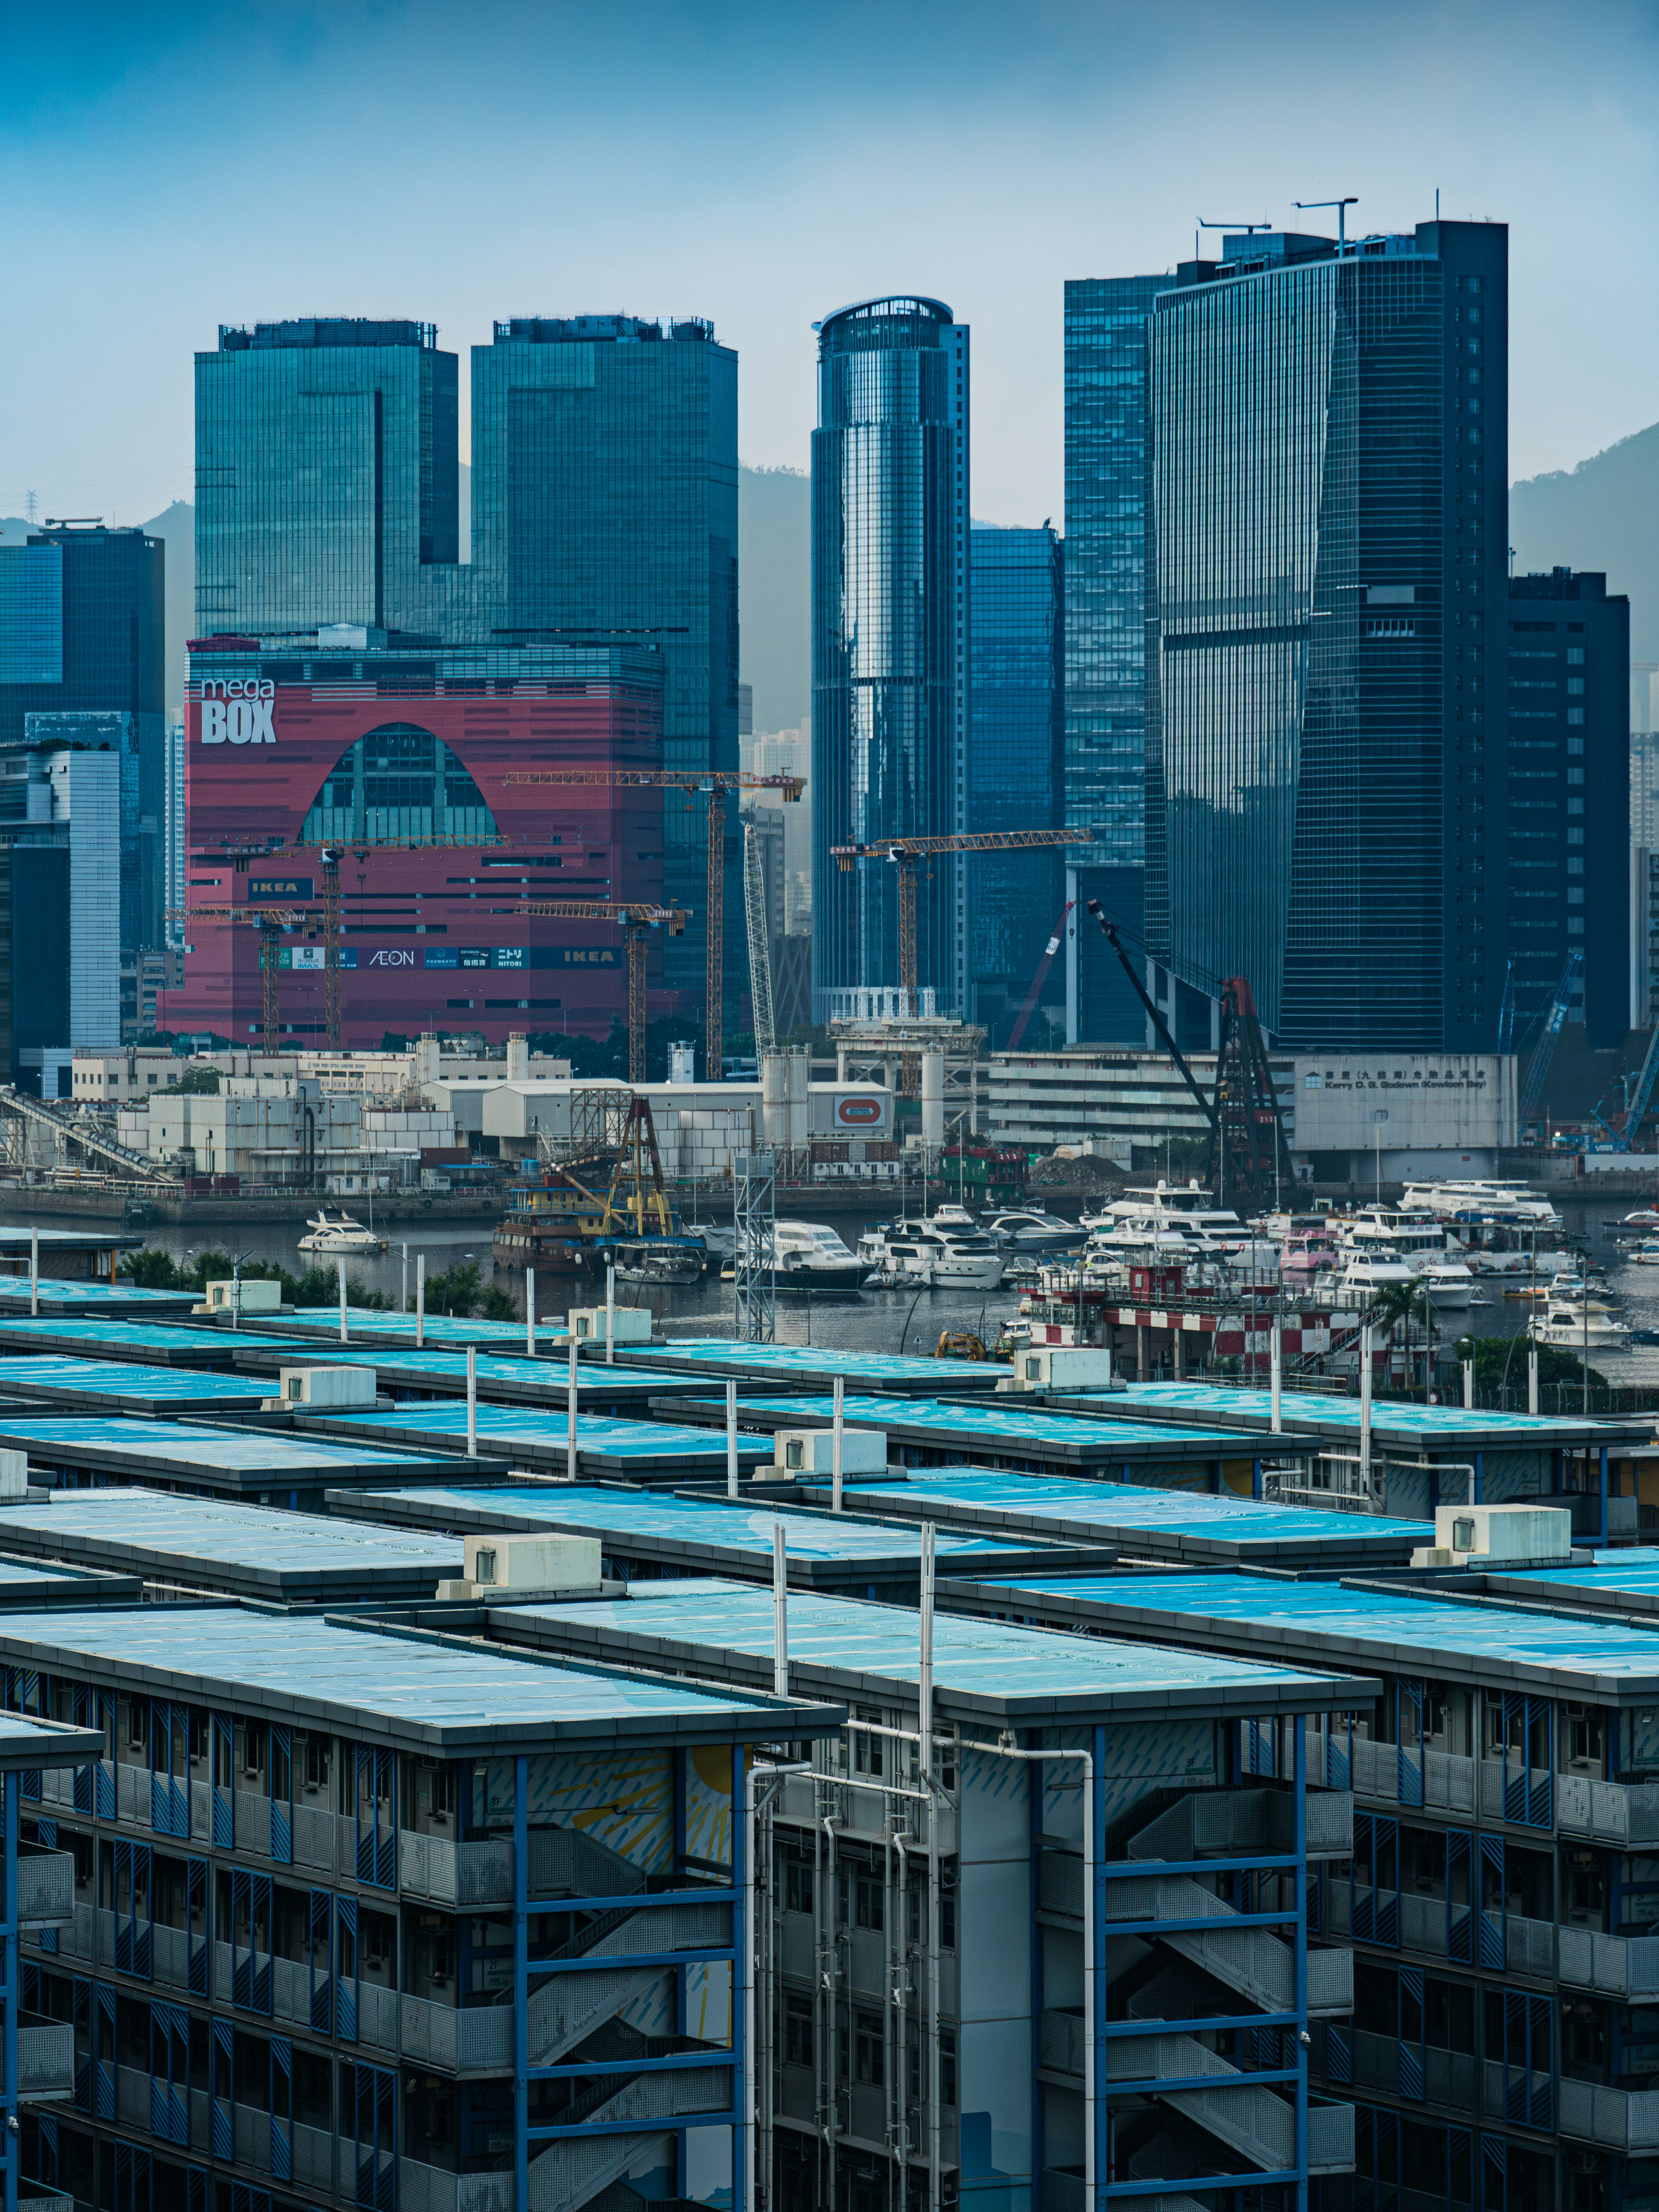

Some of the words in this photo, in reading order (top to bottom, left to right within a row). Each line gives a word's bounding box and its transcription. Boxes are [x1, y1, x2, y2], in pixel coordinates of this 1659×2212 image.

[201, 679, 275, 703] mega
[201, 699, 277, 744] BOX
[252, 883, 298, 892] IKEA
[498, 949, 521, 959] ニトリ
[564, 951, 614, 962] IKEA
[1325, 1082, 1353, 1090] Kerry
[1381, 1081, 1418, 1089] Godown
[1466, 1080, 1486, 1089] Bay)
[1636, 1748, 1645, 1757] 3F
[1186, 1758, 1196, 1767] 3F
[491, 1797, 501, 1806] 3F
[489, 1960, 499, 1969] 2F
[492, 2123, 500, 2132] 1F
